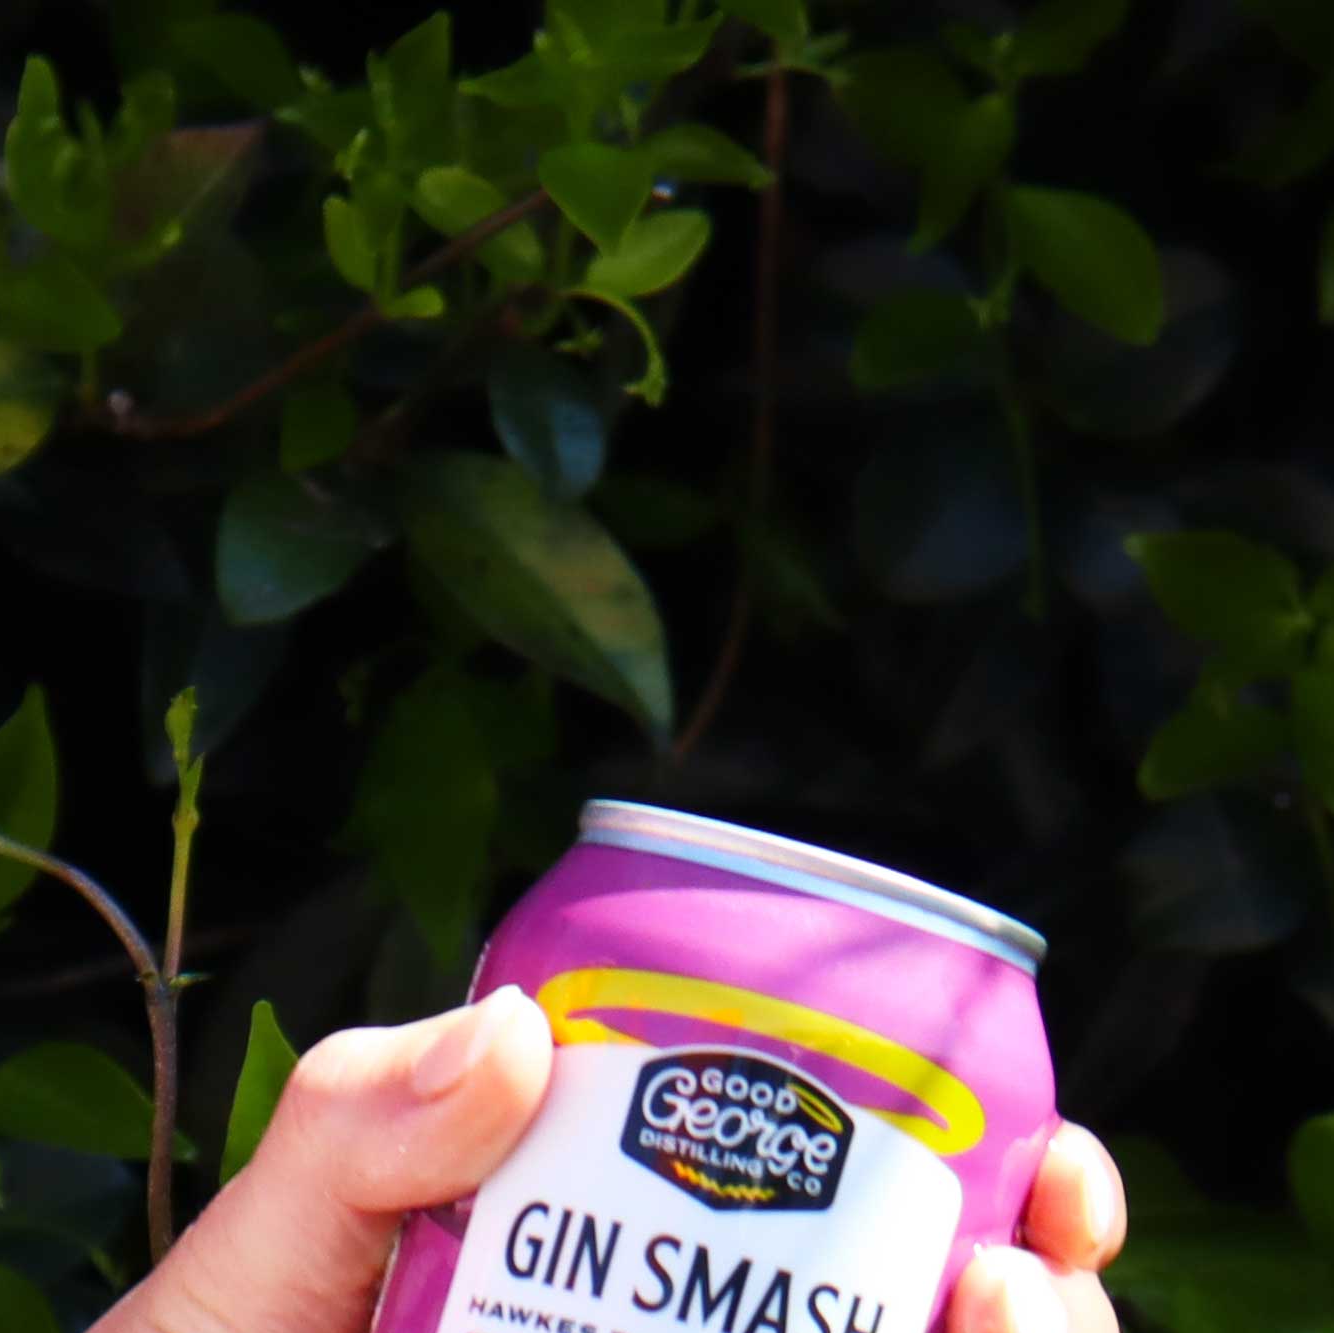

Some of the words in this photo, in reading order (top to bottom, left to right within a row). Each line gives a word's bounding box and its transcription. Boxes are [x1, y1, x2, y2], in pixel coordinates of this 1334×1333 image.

[641, 1066, 838, 1176] George
[700, 1067, 797, 1114] GOOD
[639, 1127, 764, 1179] DISTILLING
[786, 1170, 822, 1197] CO
[504, 1202, 622, 1299] GIN
